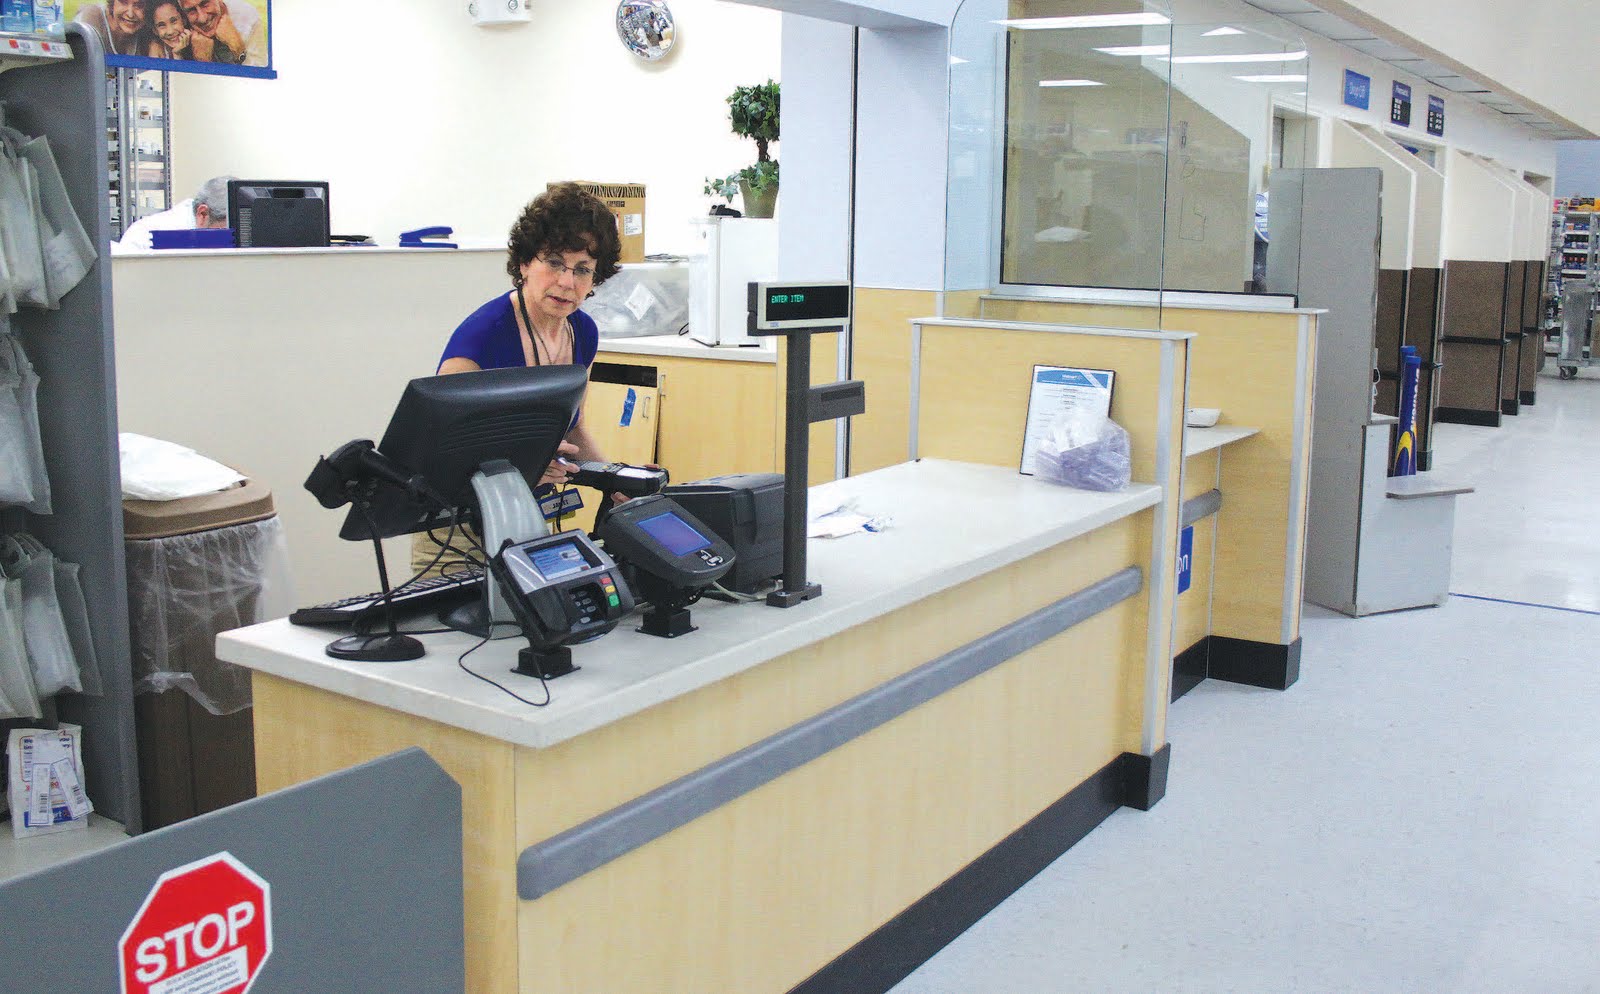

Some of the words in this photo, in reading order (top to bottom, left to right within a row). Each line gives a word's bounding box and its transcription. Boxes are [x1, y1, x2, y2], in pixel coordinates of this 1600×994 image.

[771, 295, 788, 303] ENTER
[790, 294, 804, 303] ITEM
[135, 901, 255, 983] STOP
